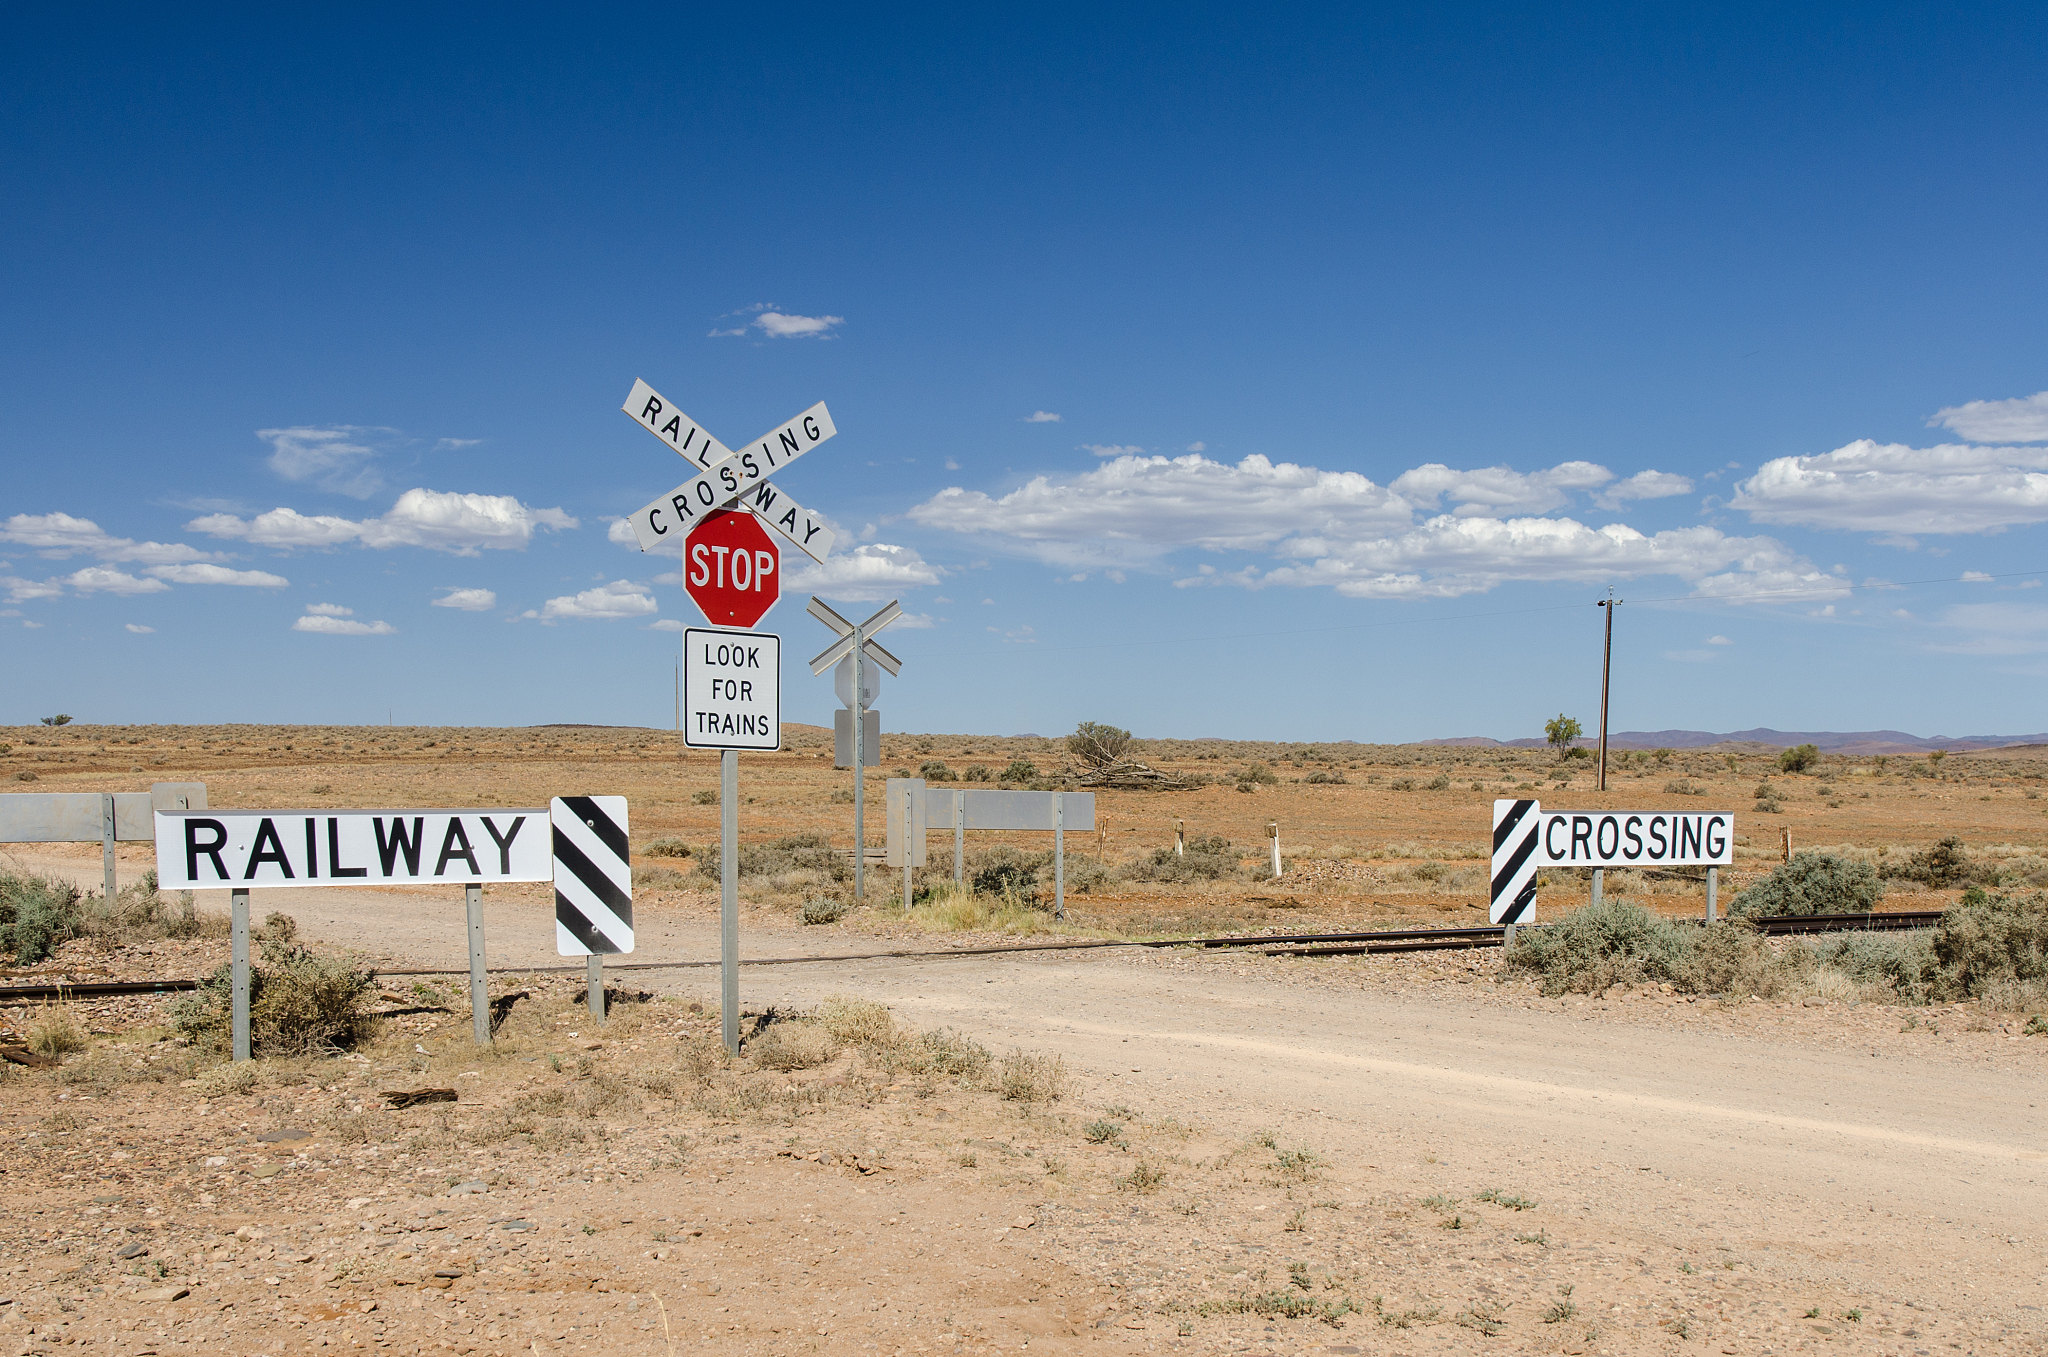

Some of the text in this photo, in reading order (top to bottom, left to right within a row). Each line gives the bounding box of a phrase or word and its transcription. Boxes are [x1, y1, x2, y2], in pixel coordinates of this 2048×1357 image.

[649, 416, 820, 535] CROSSING
[690, 543, 774, 592] STOP
[705, 643, 760, 669] LOOK
[712, 678, 752, 701] FOR
[696, 712, 769, 736] TRAINS
[184, 816, 526, 881] RAILWAY
[1545, 815, 1726, 860] CROSSING
